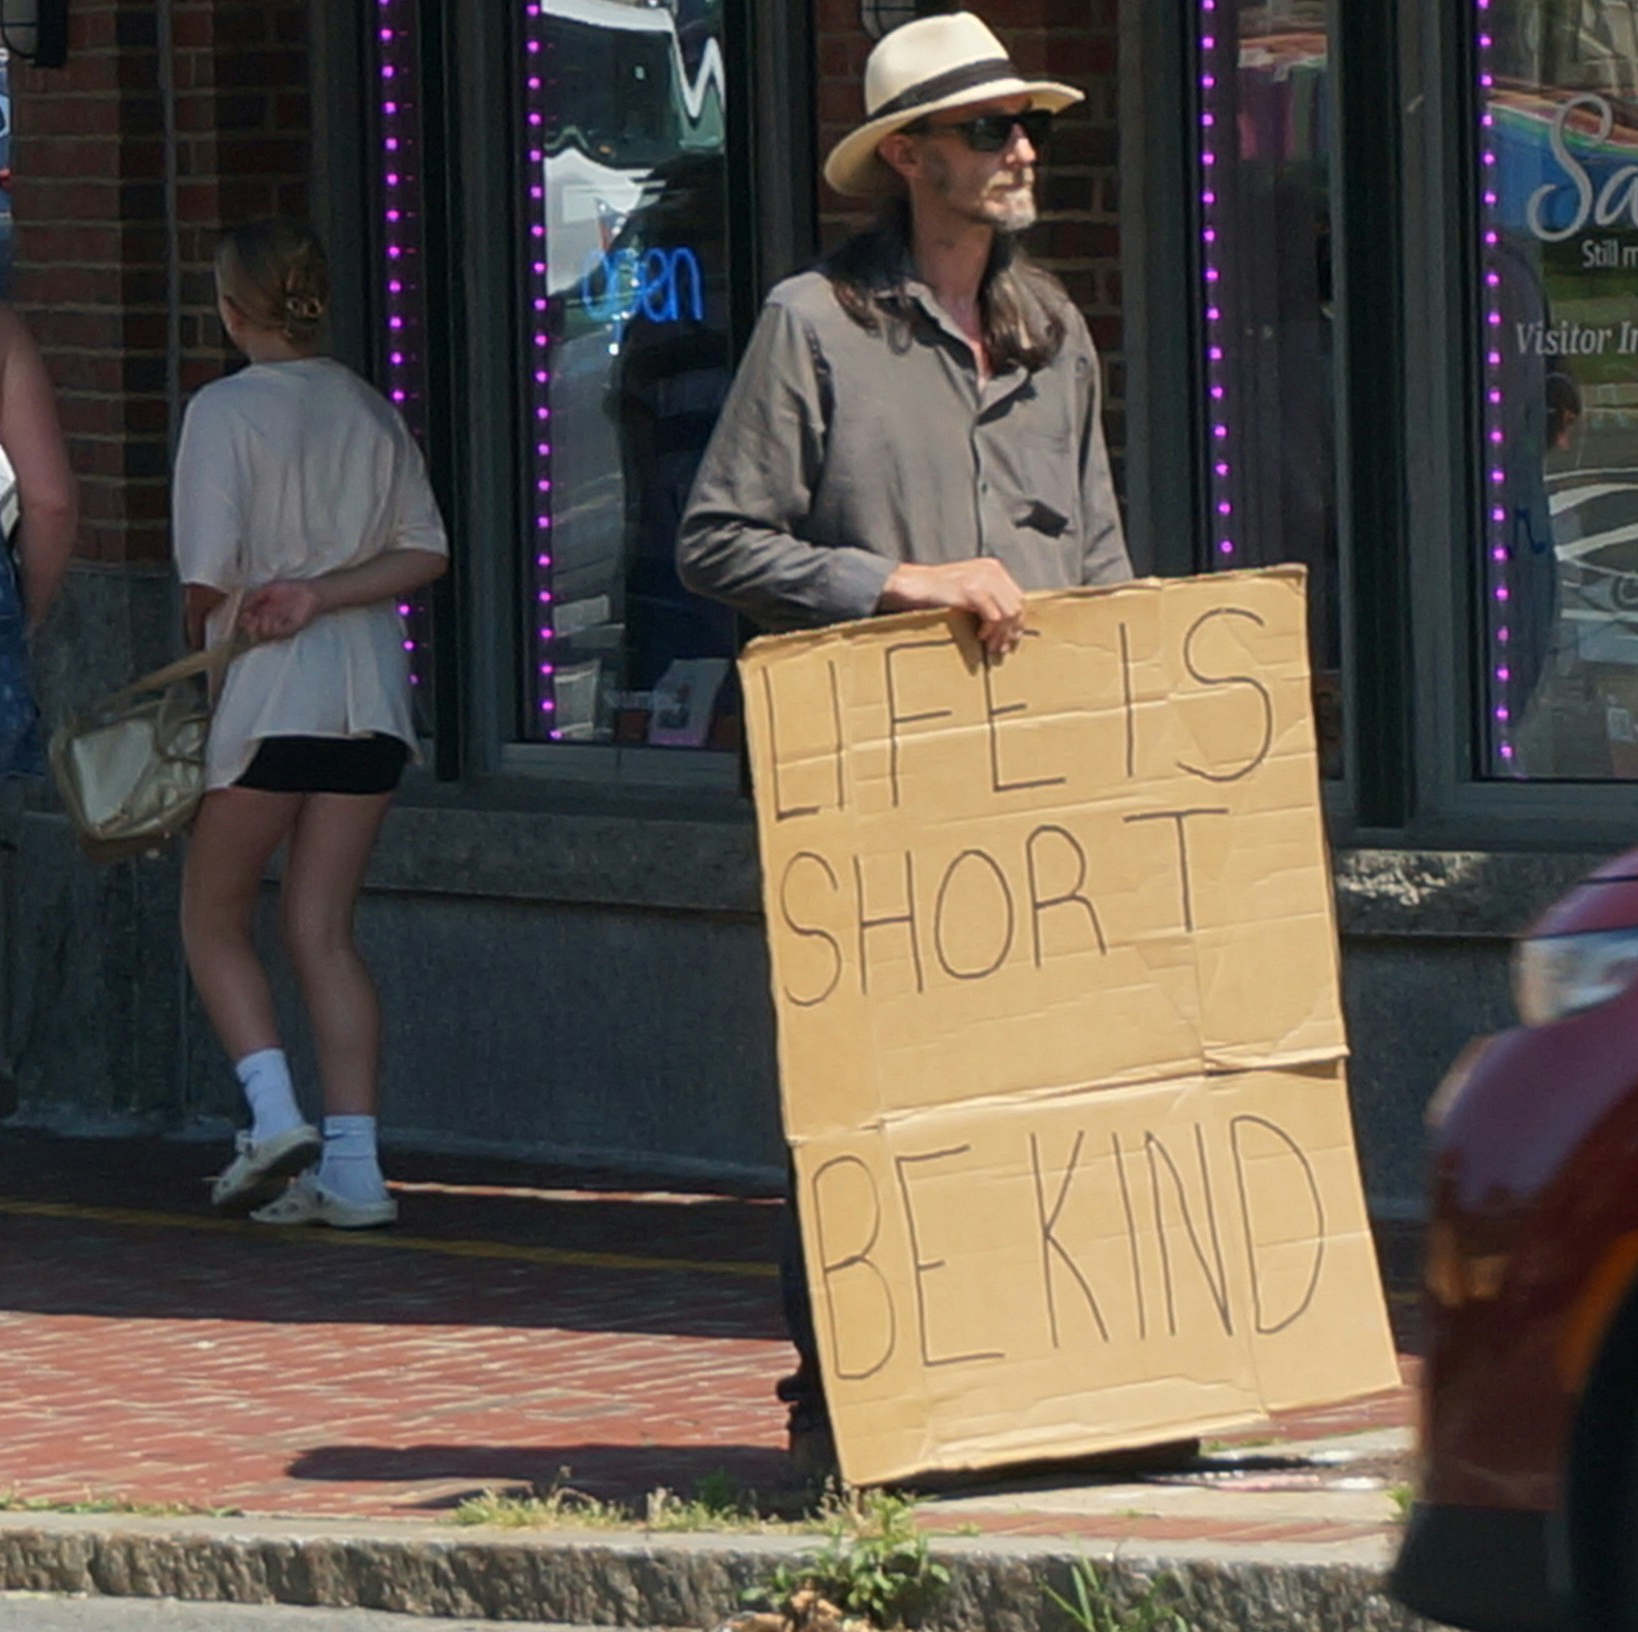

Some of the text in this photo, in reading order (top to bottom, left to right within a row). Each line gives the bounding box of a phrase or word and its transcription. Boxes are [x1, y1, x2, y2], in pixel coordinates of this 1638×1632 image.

[581, 245, 704, 358] open
[1582, 237, 1619, 267] Still
[1516, 321, 1611, 355] Visitor
[763, 607, 1272, 822] LIFE IS
[781, 808, 1229, 1008] SHORT
[813, 1115, 1324, 1380] BE KIND
